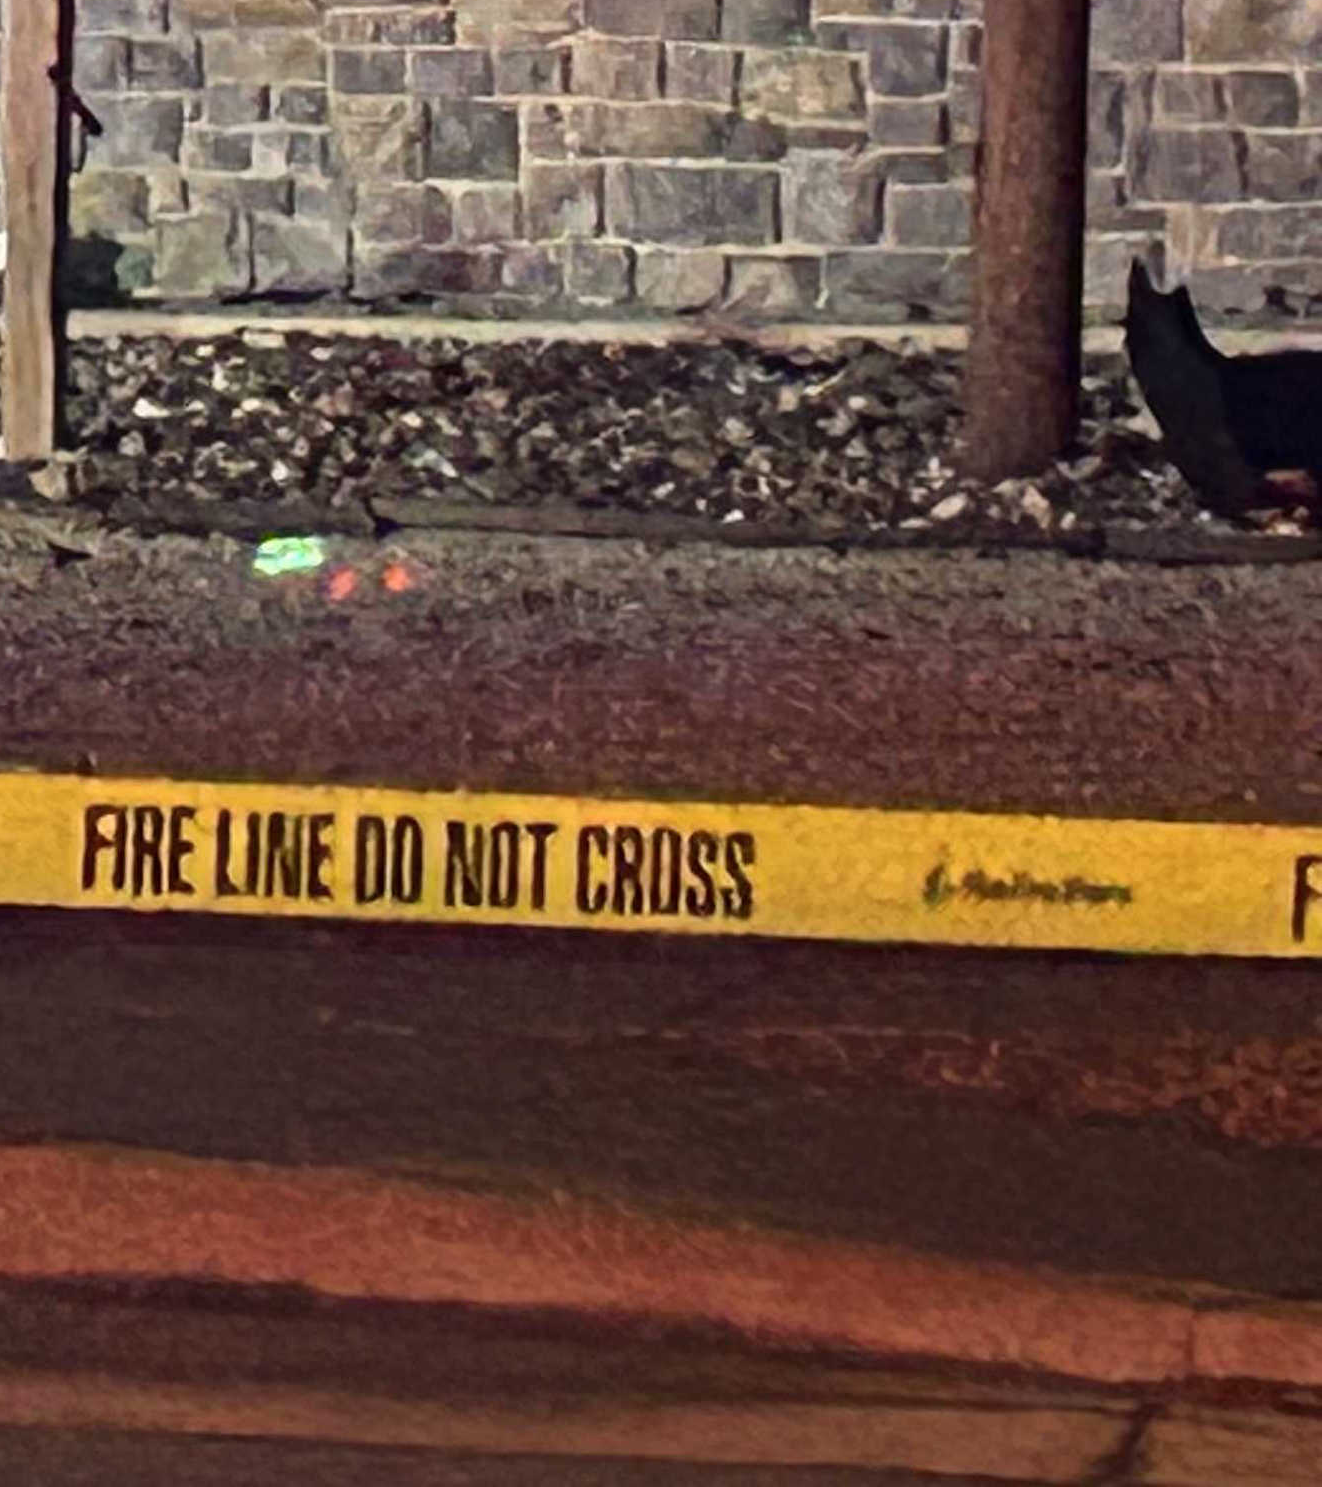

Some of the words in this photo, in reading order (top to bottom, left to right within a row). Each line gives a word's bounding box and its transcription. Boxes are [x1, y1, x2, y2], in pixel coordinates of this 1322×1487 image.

[81, 804, 197, 897] FIRE
[215, 808, 335, 900] LINE
[354, 814, 424, 906] DO
[443, 820, 559, 911] NOT
[575, 825, 755, 920] CROSS
